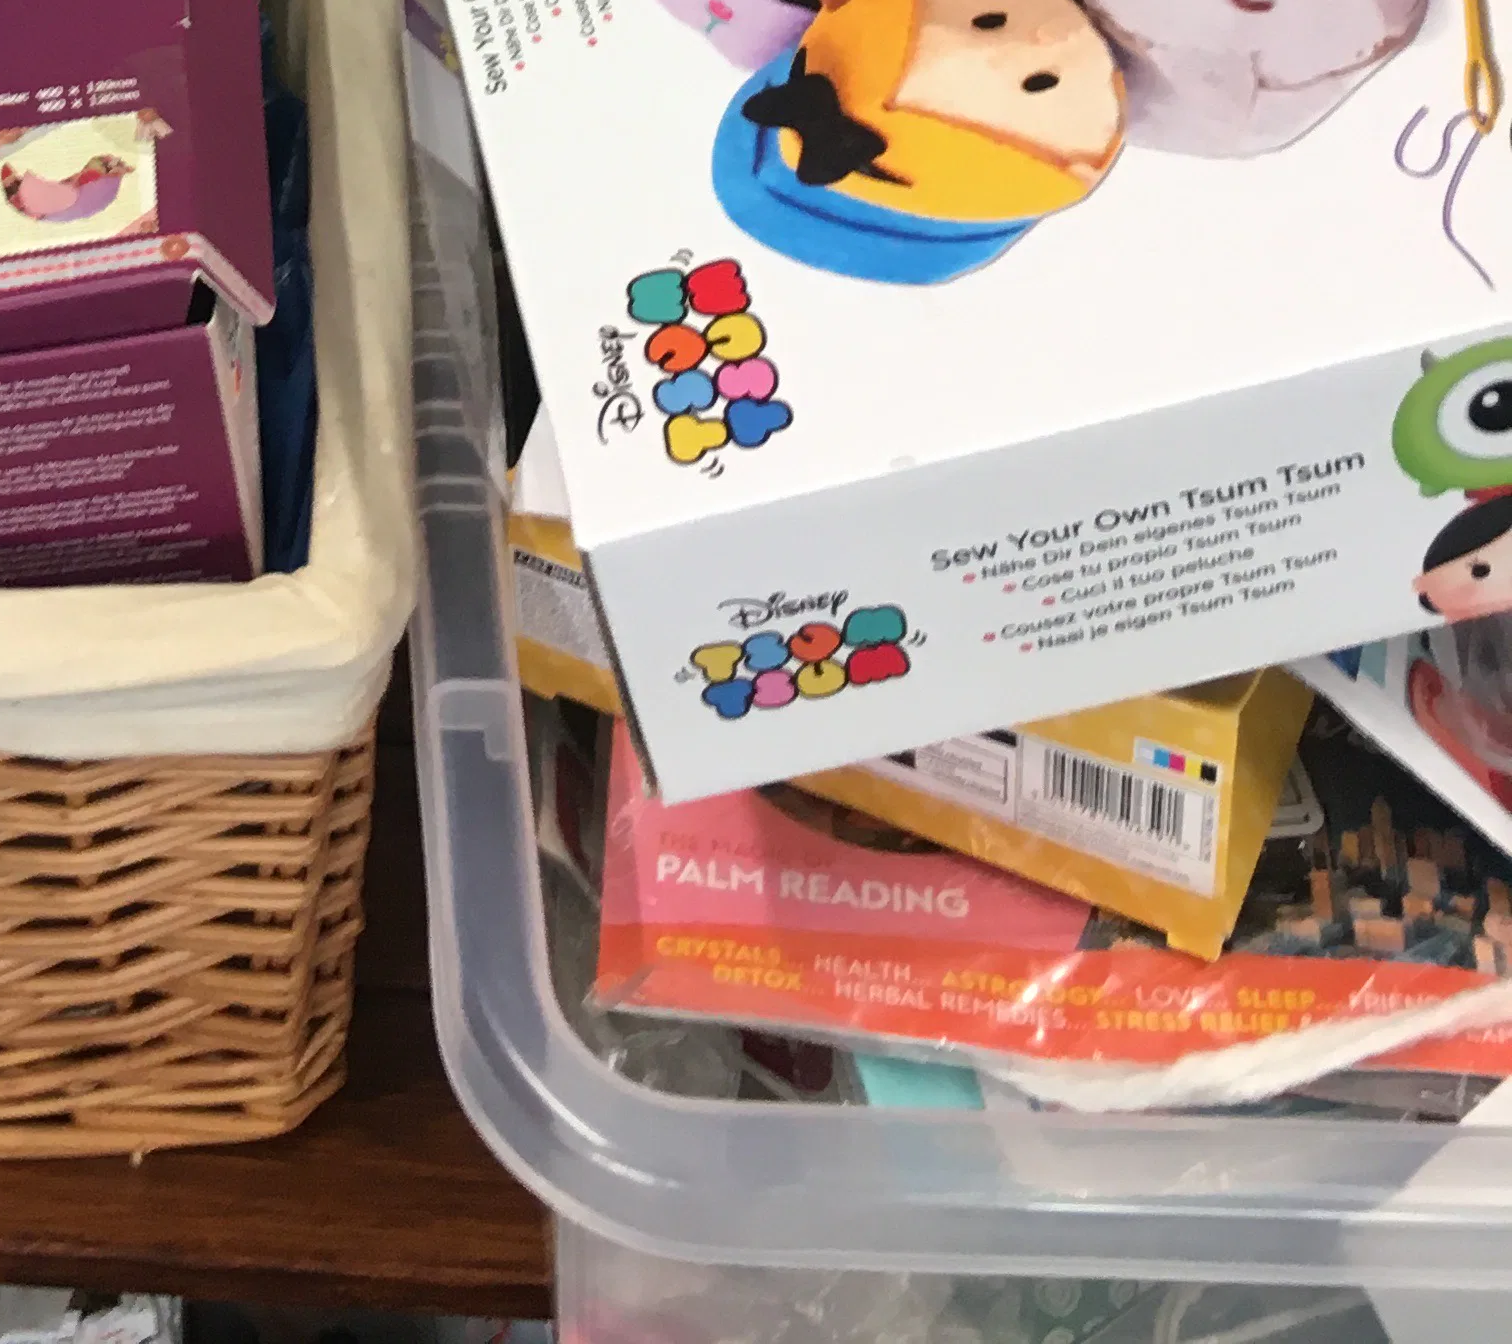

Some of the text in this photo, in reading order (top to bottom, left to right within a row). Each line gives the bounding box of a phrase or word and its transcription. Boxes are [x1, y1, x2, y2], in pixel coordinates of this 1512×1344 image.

[470, 6, 495, 52] Your
[483, 53, 509, 96] Sew
[929, 450, 1366, 574] Sew Your Own Tsum Tsum
[1129, 513, 1215, 547] eigenes
[1221, 496, 1279, 522] Tsum
[1283, 481, 1341, 506] Tsum
[1020, 568, 1075, 592] Cose
[1182, 528, 1240, 553] Tsum
[1244, 512, 1302, 538] Tsum
[1128, 566, 1167, 587] tuo
[1170, 545, 1254, 579] peluche
[717, 588, 849, 630] Disney
[1000, 546, 1337, 640] Cousez votre propre Tsum Tsum
[1113, 607, 1173, 636] eigen
[1177, 591, 1235, 616] Tsum
[1239, 577, 1296, 602] Tsum
[655, 853, 970, 918] PALM READING
[834, 978, 931, 1011] HERBAL
[1095, 1010, 1193, 1033] STRESS
[1200, 1012, 1288, 1035] RELIEF
